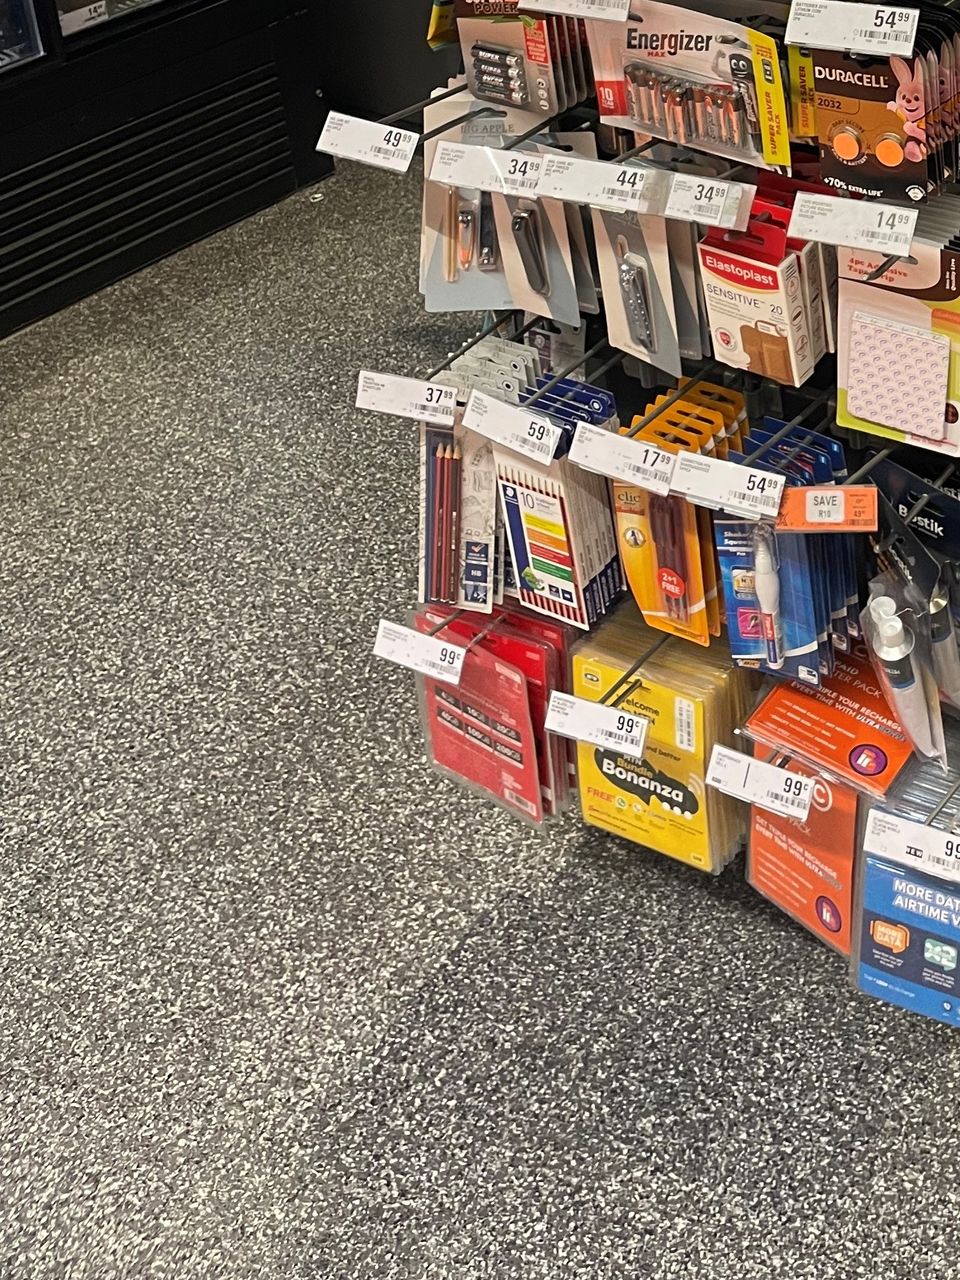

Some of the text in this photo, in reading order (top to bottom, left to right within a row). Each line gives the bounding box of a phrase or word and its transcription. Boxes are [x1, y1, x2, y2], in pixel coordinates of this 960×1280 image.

[474, 3, 519, 14] POWER
[873, 9, 910, 28] 5499
[626, 27, 713, 55] Energizer
[815, 66, 889, 89] DURACELL
[599, 86, 613, 101] 10
[817, 97, 842, 110] 2032
[764, 91, 779, 156] SUPER SAVER
[774, 113, 783, 137] PACK
[824, 177, 868, 196] +70% EXTRA
[705, 255, 774, 286] Elastoplast
[706, 282, 760, 308] SENSITIVE
[769, 303, 783, 316] 20
[520, 491, 535, 510] 10
[617, 491, 642, 505] clic
[813, 495, 838, 507] SAVE
[470, 569, 482, 578] HB
[661, 572, 678, 585] 2+1
[661, 582, 681, 598] FREE
[790, 680, 855, 718] EVERY TIME WITH
[838, 694, 860, 712] YOUR
[657, 749, 681, 762] better
[602, 758, 684, 803] Bonanza
[587, 786, 613, 803] FREE
[788, 846, 804, 863] WITH
[892, 877, 933, 902] MORE
[892, 894, 950, 924] AIRTIME
